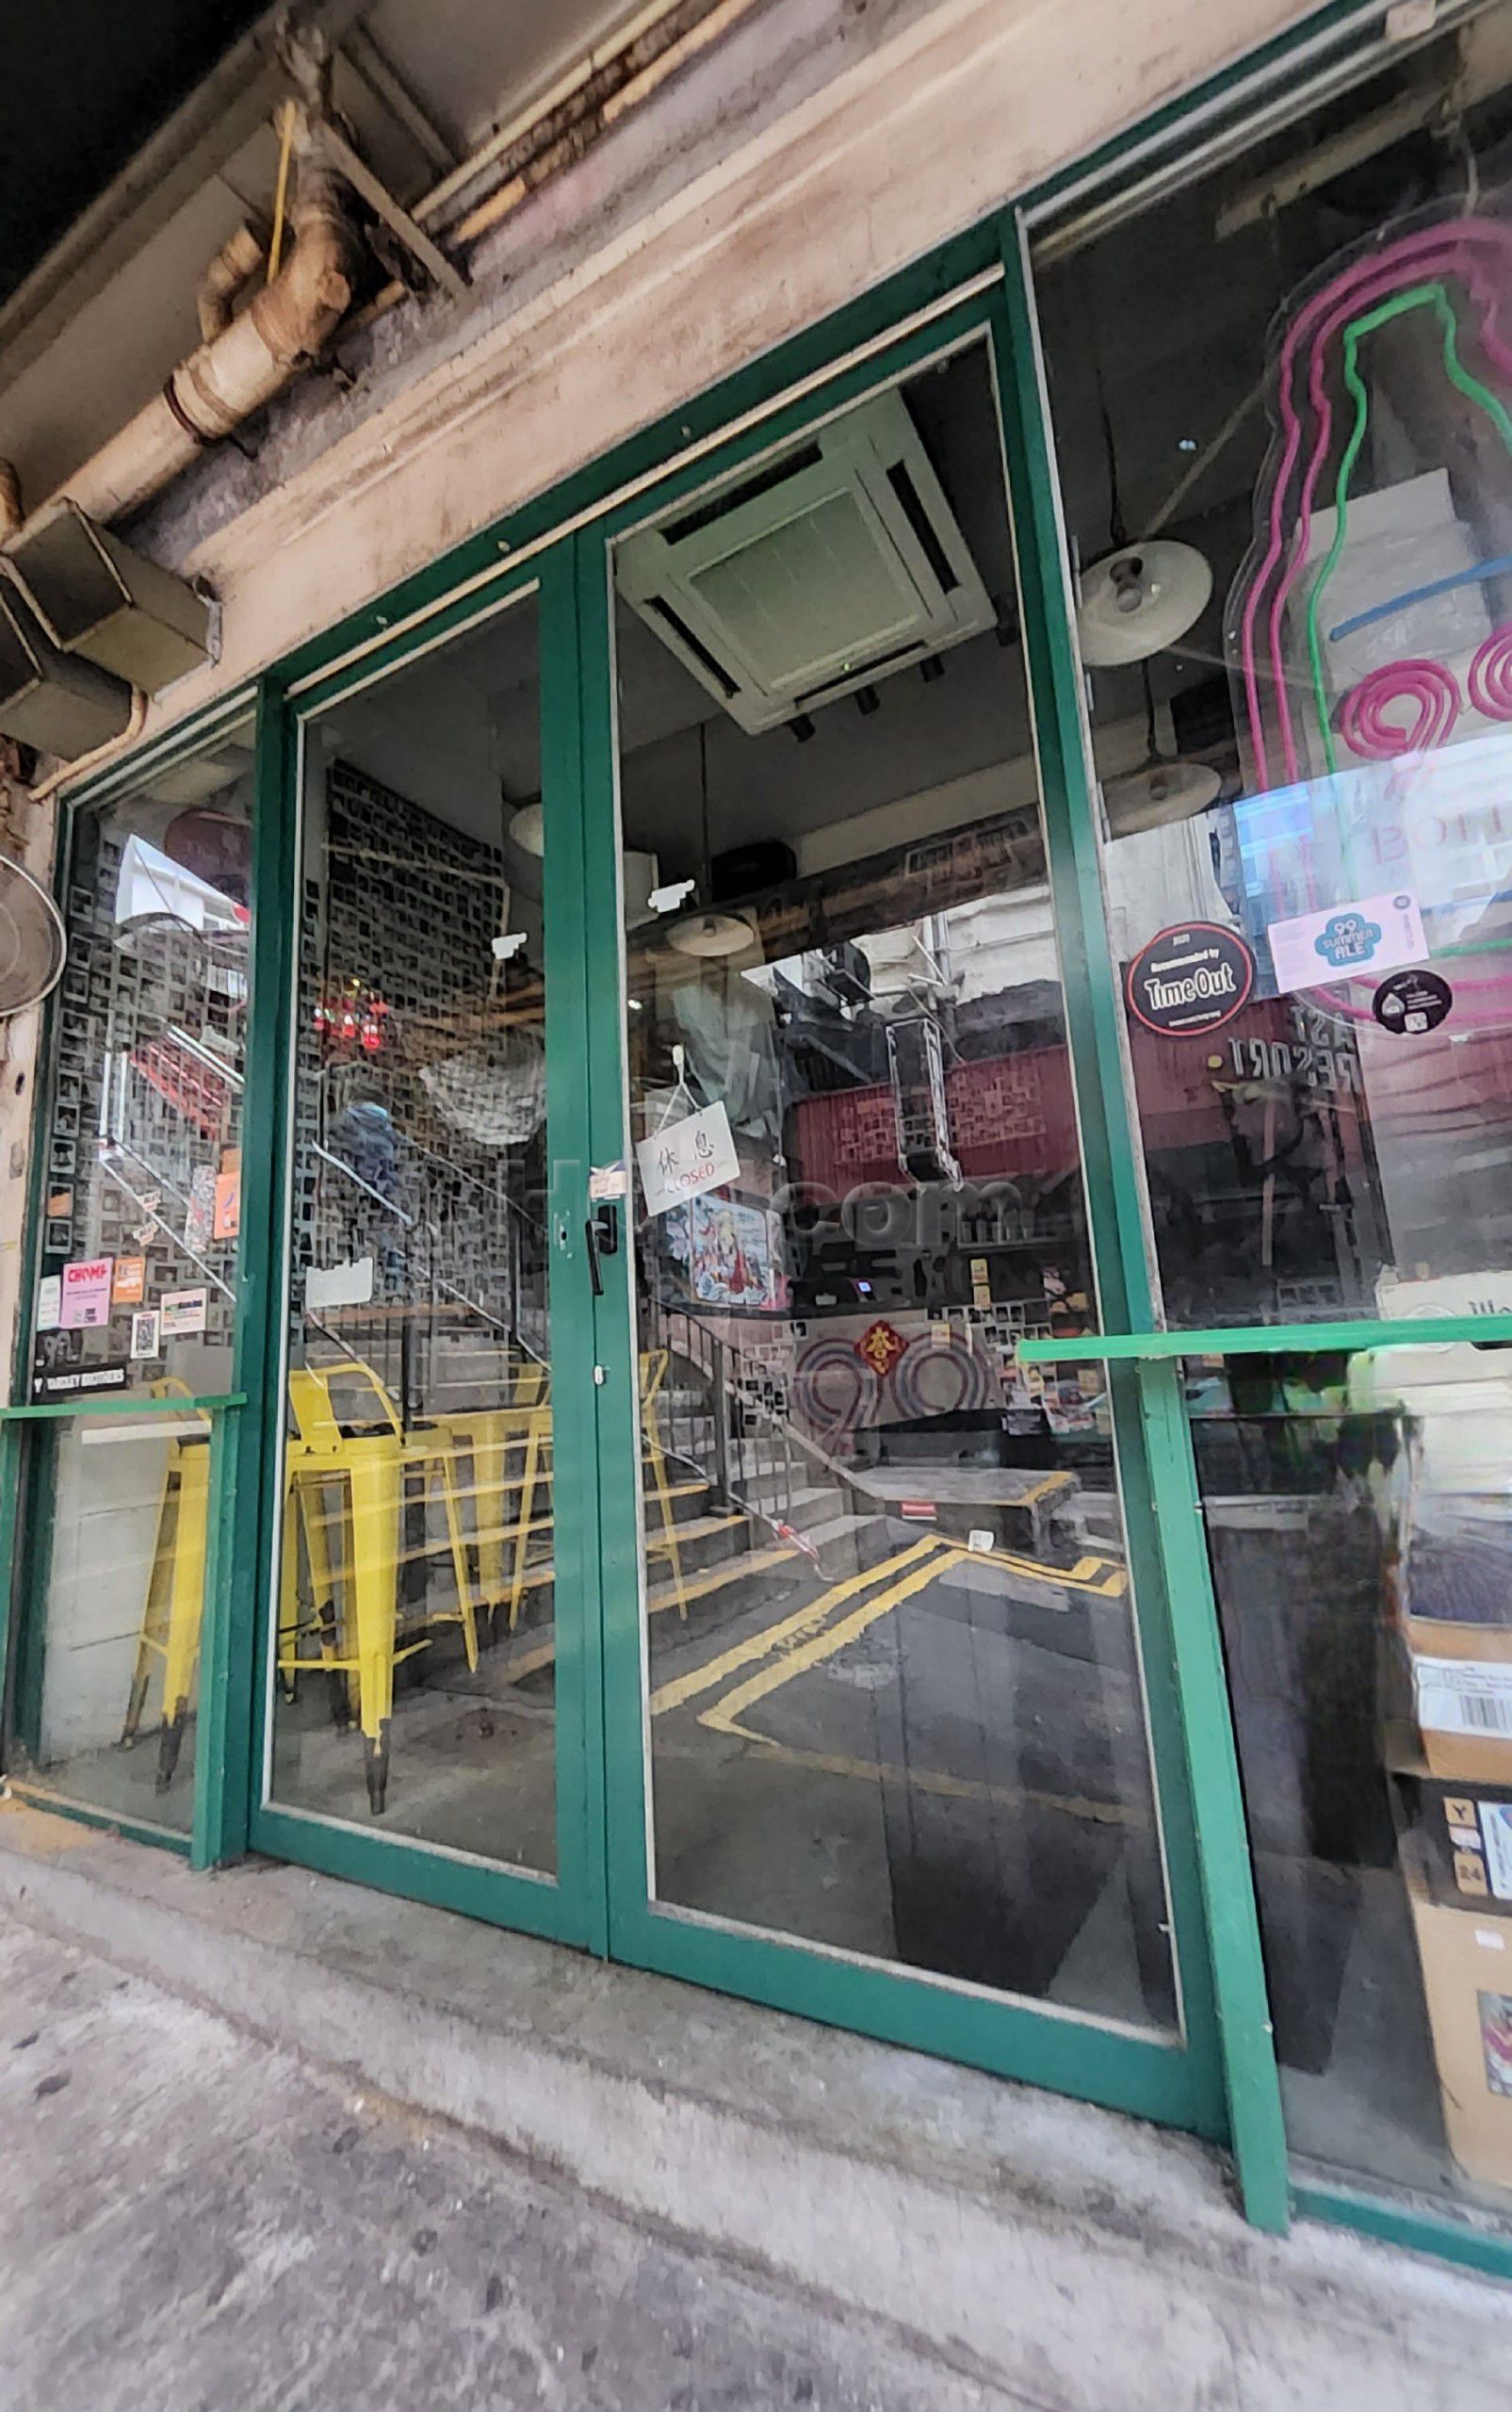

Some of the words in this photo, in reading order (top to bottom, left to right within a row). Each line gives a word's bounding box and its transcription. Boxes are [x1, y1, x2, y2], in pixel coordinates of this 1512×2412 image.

[1334, 920, 1357, 935] 99
[1334, 943, 1366, 960] ALE
[657, 1129, 716, 1177] 休息
